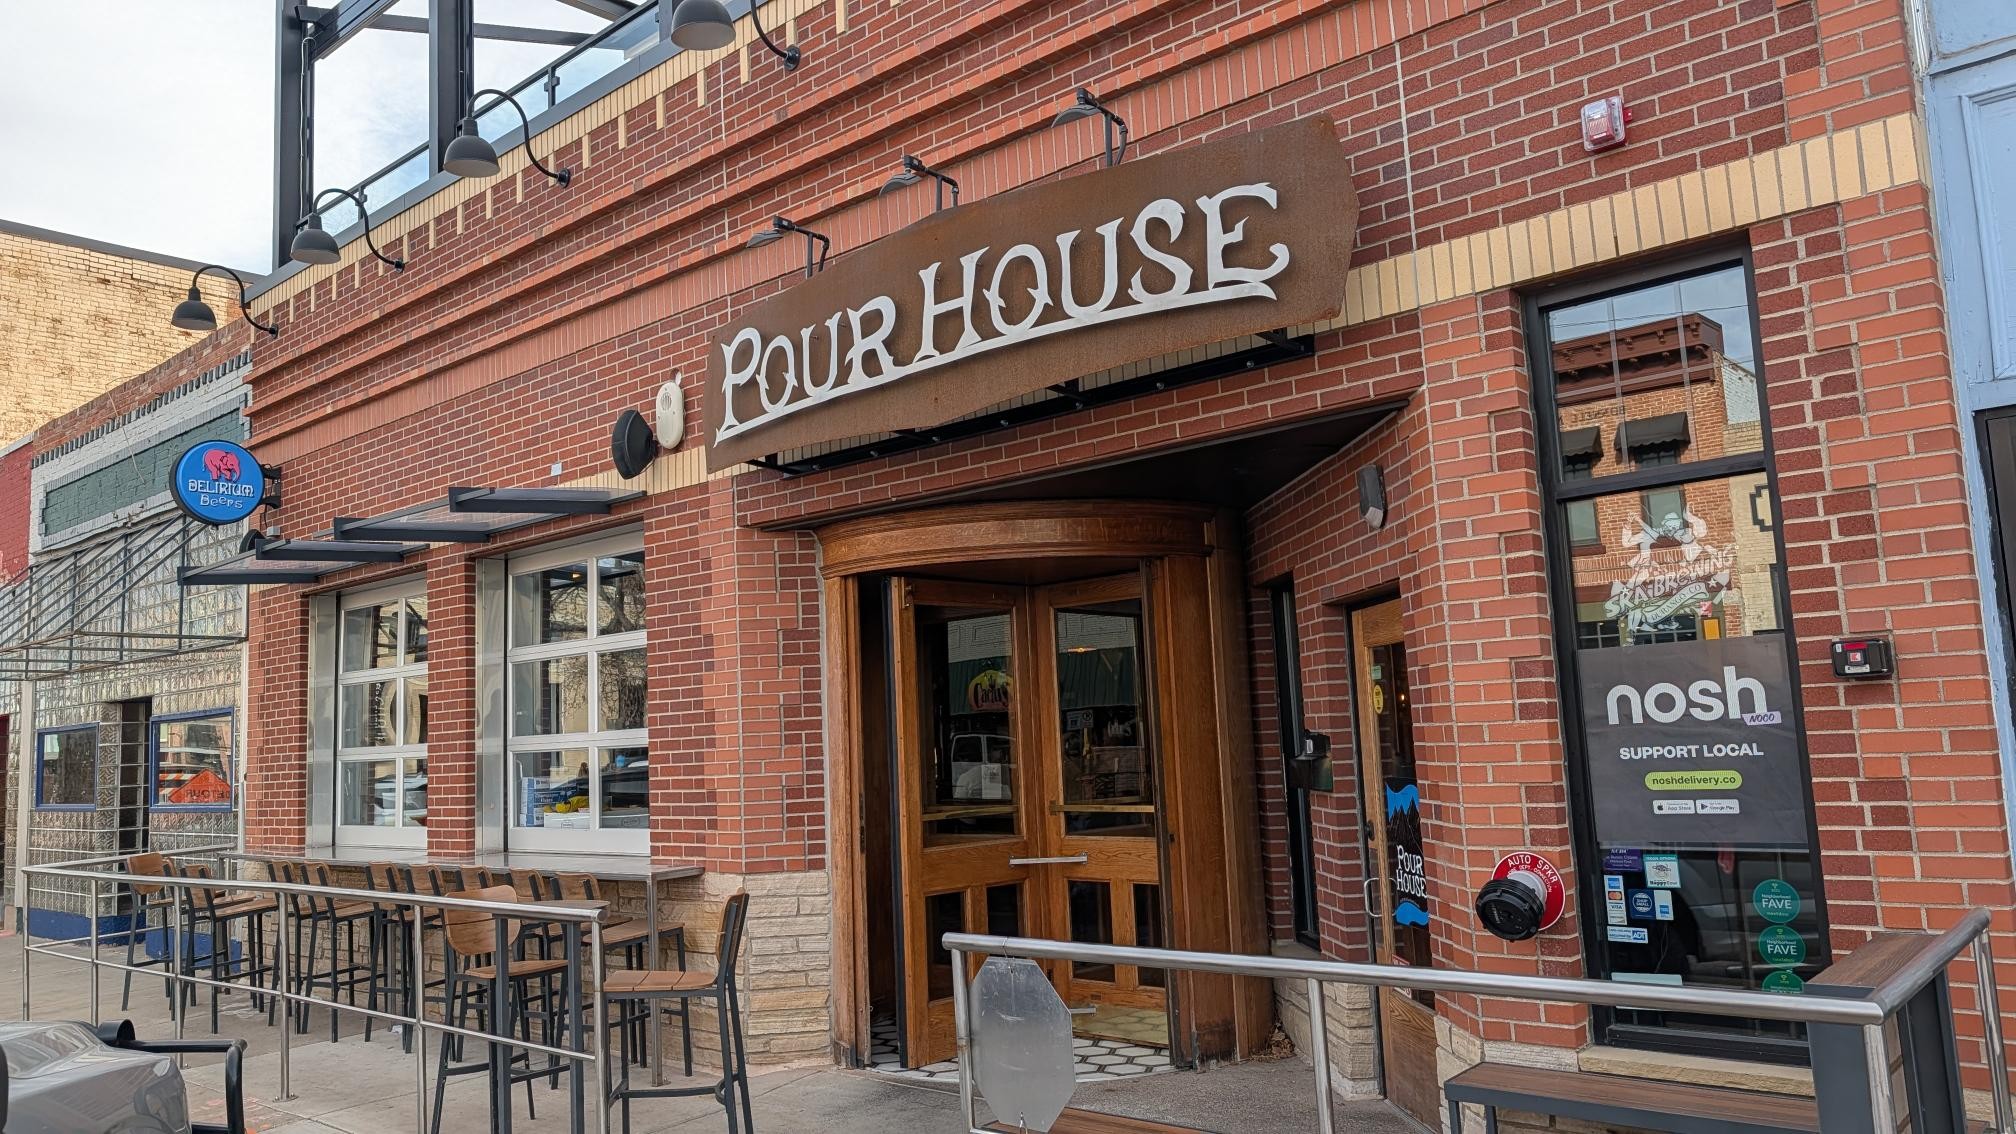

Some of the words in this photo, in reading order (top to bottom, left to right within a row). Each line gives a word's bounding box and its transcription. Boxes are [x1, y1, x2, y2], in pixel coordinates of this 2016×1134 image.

[717, 295, 896, 435] POUR
[915, 182, 1289, 364] HOUSE
[188, 480, 254, 497] DELIRIUM
[1606, 665, 1768, 725] nosh
[1749, 713, 1775, 723] NOCO
[1619, 745, 1700, 760] SUPPORT
[1703, 742, 1765, 758] LOCAL
[1652, 775, 1737, 786] noshdelivery.co
[1396, 844, 1424, 876] POUR
[1507, 854, 1532, 868] AUTO
[1536, 859, 1558, 883] SPKR
[1395, 868, 1428, 898] HOUSE
[1762, 898, 1793, 909] FAVE
[1767, 944, 1798, 956] FAVE
